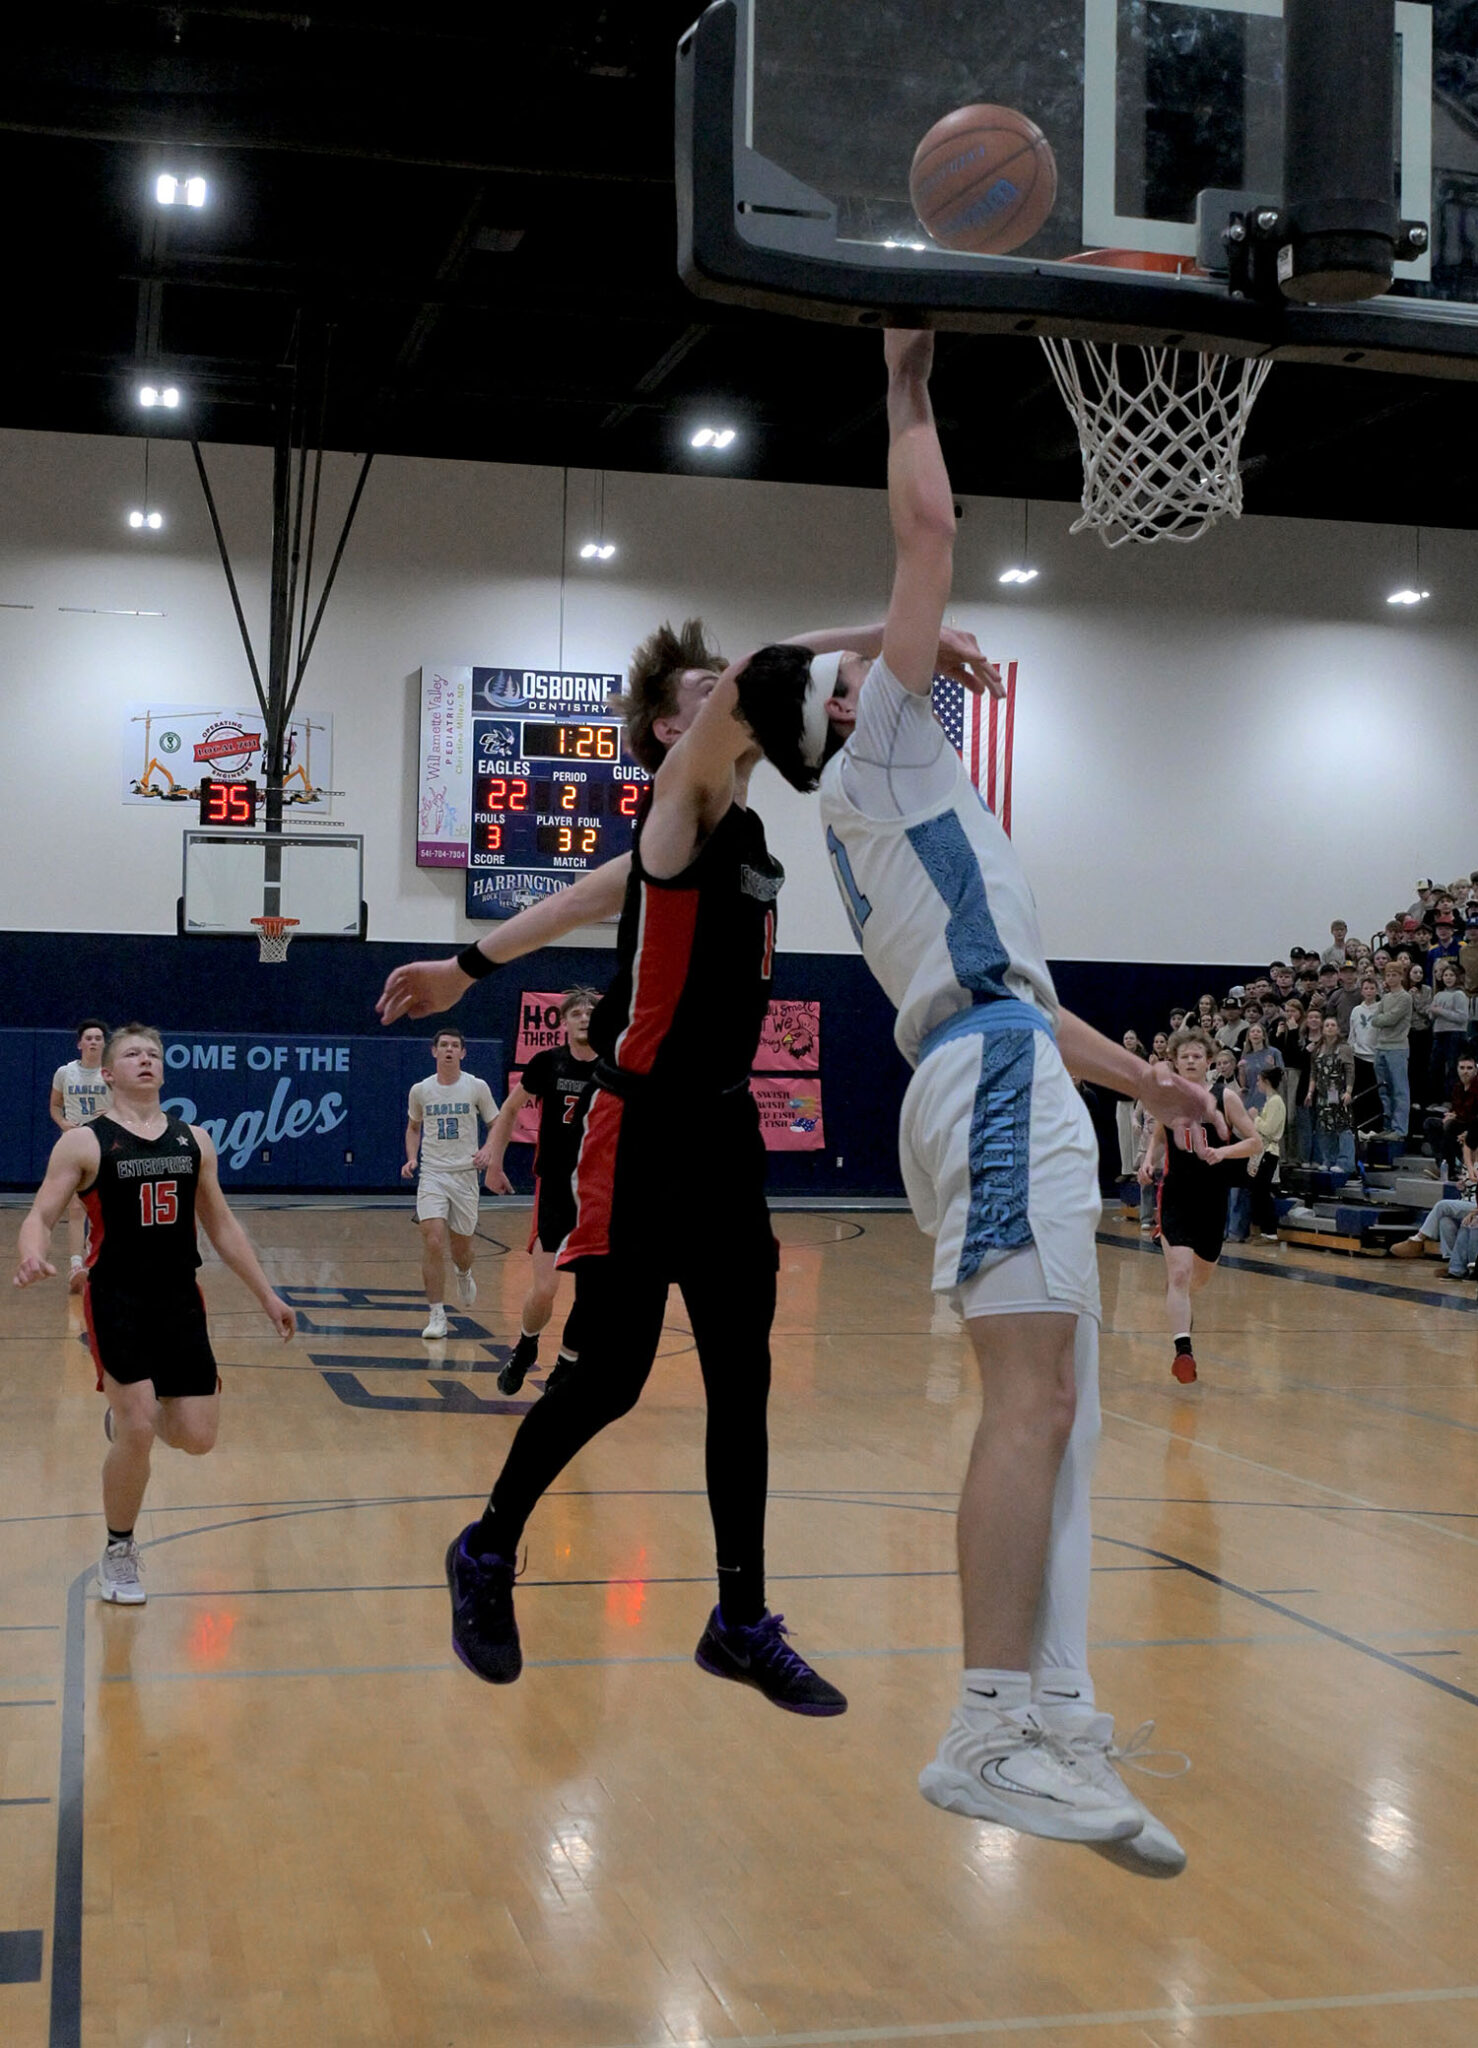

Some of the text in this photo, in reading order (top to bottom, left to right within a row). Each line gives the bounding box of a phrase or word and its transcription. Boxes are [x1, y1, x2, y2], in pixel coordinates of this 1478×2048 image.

[427, 673, 448, 711] Valley
[528, 702, 608, 713] DENTISTRY
[202, 720, 243, 738] OPERATING
[445, 692, 454, 765] PEDIATRICS
[198, 743, 234, 756] LOCAL
[559, 727, 615, 758] 1:26
[212, 761, 253, 778] ENGINEERS
[478, 760, 531, 775] EAGLES
[613, 766, 655, 781] GUES
[553, 771, 587, 782] PERIOD
[208, 783, 251, 821] 35
[488, 778, 528, 811] 22
[562, 785, 577, 809] 2
[474, 813, 506, 824] FOULS
[537, 815, 602, 828] PLAYER FOUL
[487, 824, 502, 850] 3
[559, 828, 597, 853] 3 2
[474, 854, 506, 865] SCORE
[553, 857, 587, 868] MATCH
[522, 1031, 560, 1047] THERE
[165, 1044, 350, 1072] OME OF THE
[68, 1084, 107, 1095] EAGLES
[426, 1103, 470, 1116] EAGLES
[773, 1111, 796, 1120] FISH
[437, 1118, 459, 1139] 12
[765, 1121, 788, 1129] FISH
[982, 1088, 1018, 1170] LINN
[117, 1155, 194, 1179] ENTERPRISE
[139, 1181, 179, 1226] 15
